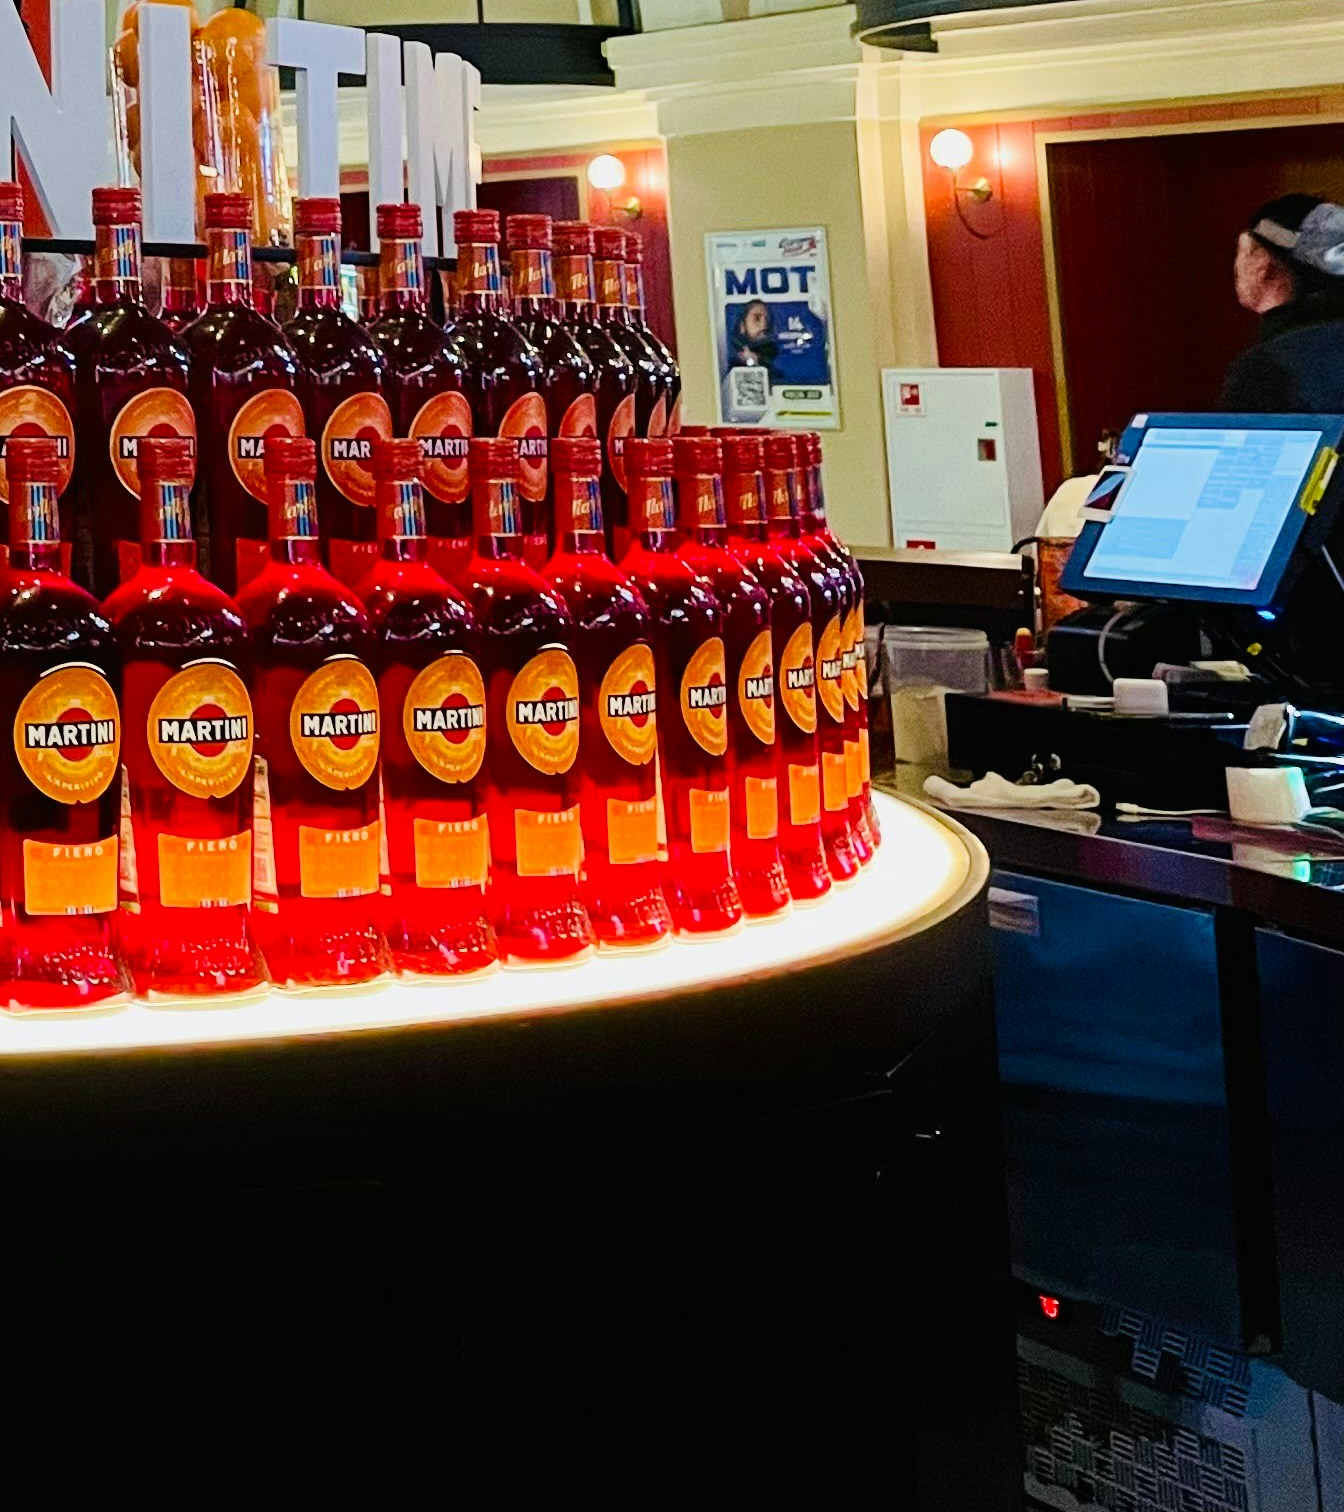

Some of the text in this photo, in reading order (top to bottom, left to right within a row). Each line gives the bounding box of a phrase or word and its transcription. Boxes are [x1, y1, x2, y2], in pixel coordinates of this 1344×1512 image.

[725, 266, 815, 295] МОТ
[28, 721, 114, 746] MARTINI
[161, 717, 247, 742] MARTINI
[303, 711, 377, 736] MARTINI
[53, 847, 104, 858] FIERO
